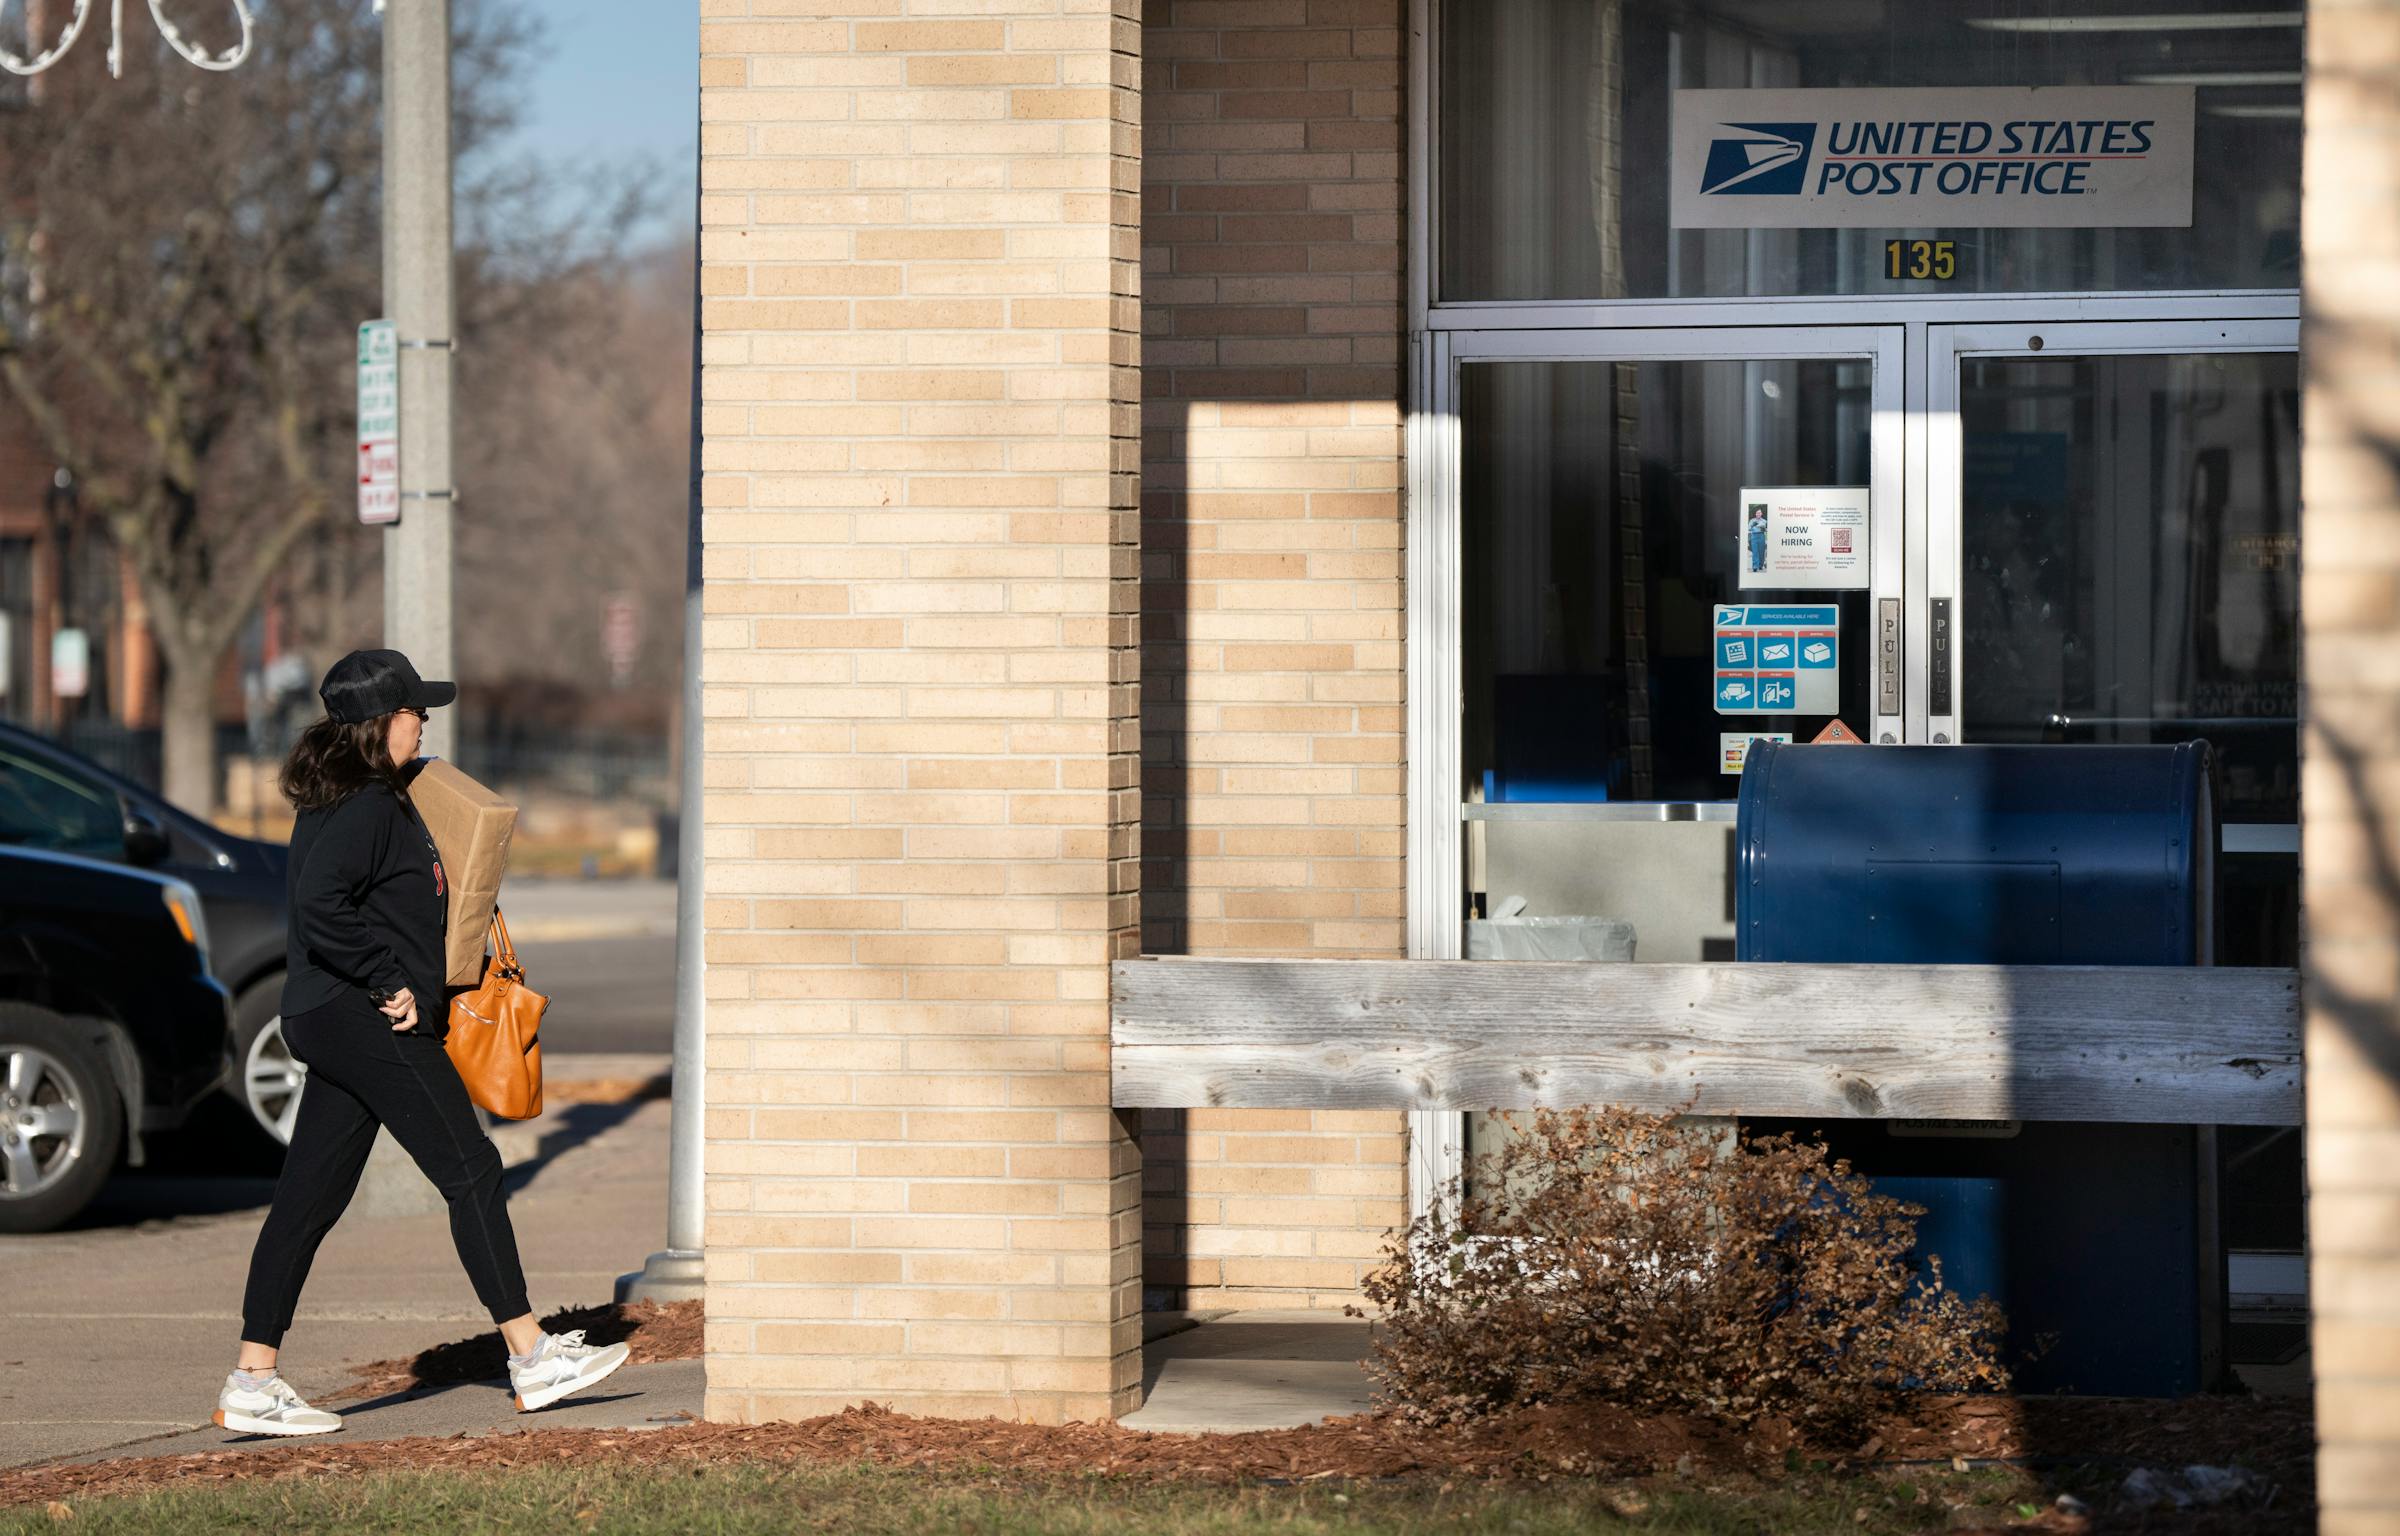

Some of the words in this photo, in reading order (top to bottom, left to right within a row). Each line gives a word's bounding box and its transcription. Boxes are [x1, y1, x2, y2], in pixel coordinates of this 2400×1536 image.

[1828, 122, 1992, 154] UNITED
[1999, 121, 2154, 153] STATES
[1817, 161, 1935, 195] POST
[1937, 161, 2091, 195] OFFICE
[1887, 240, 1955, 279] 135
[1781, 538, 1813, 546] HIRING
[1785, 526, 1809, 534] NOW
[1885, 620, 1895, 694] PULL
[1936, 620, 1946, 693] PULL
